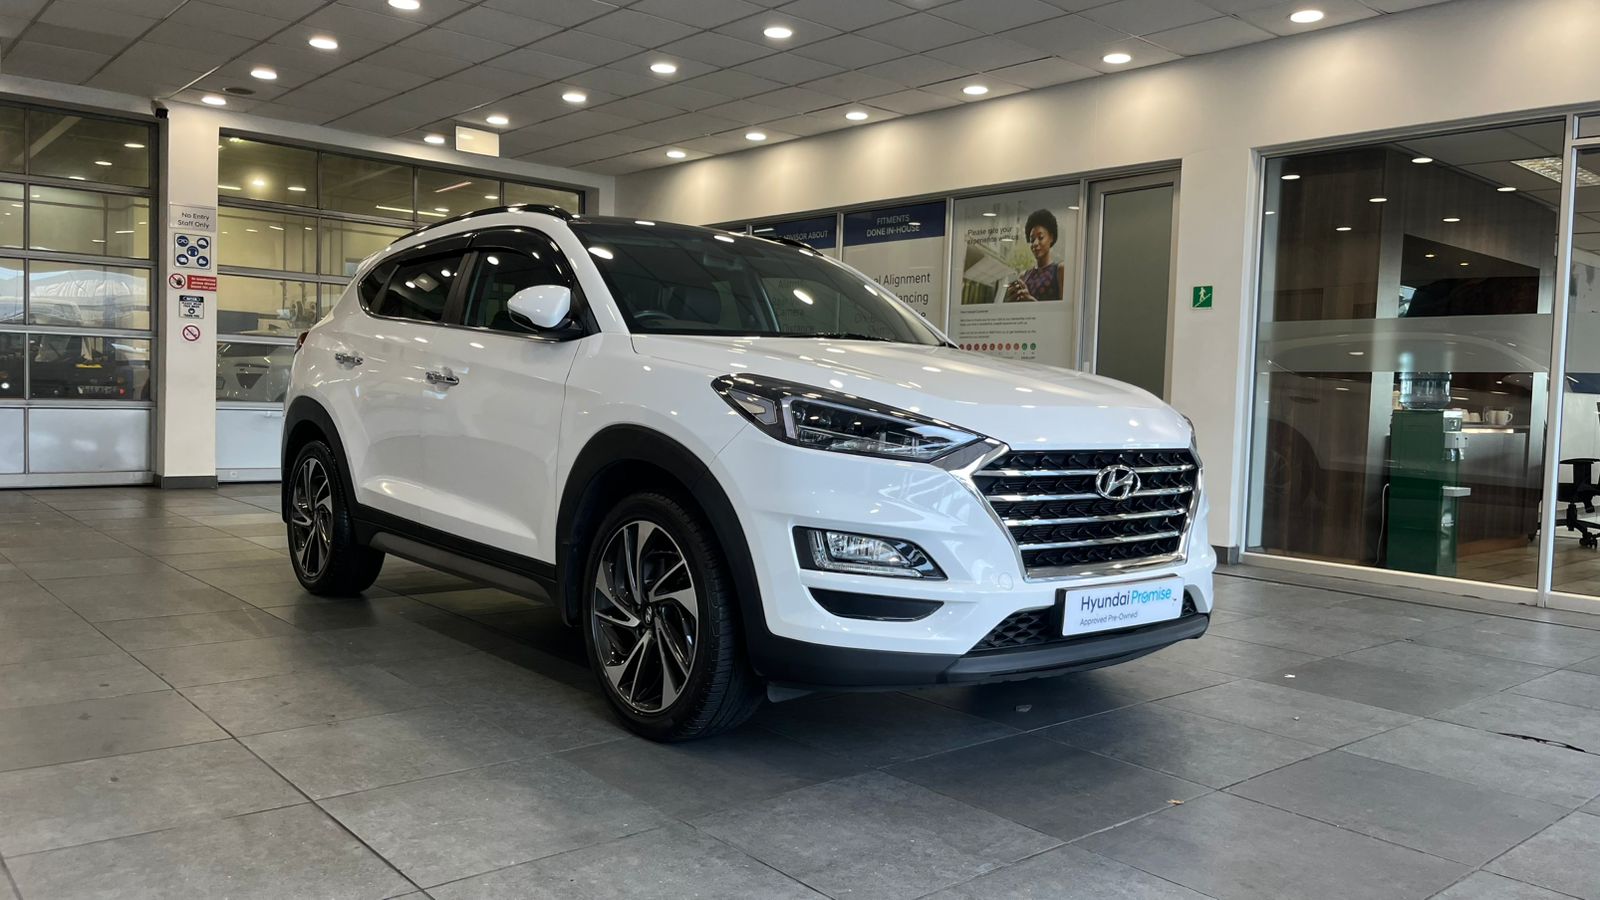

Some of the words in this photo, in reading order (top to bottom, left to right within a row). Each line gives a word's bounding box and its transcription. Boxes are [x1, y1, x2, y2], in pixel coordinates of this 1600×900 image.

[193, 213, 210, 221] Entry
[876, 214, 910, 225] FITMENTS
[194, 221, 210, 229] Only
[866, 227, 886, 238] DONE
[886, 224, 921, 236] IN-HOUSE
[808, 230, 829, 240] ABOUT
[883, 273, 930, 288] Alignment
[1080, 590, 1130, 613] Hyundai
[1131, 587, 1172, 605] Promise
[1079, 615, 1108, 626] Approved
[1108, 610, 1138, 623] Pre-Owned
